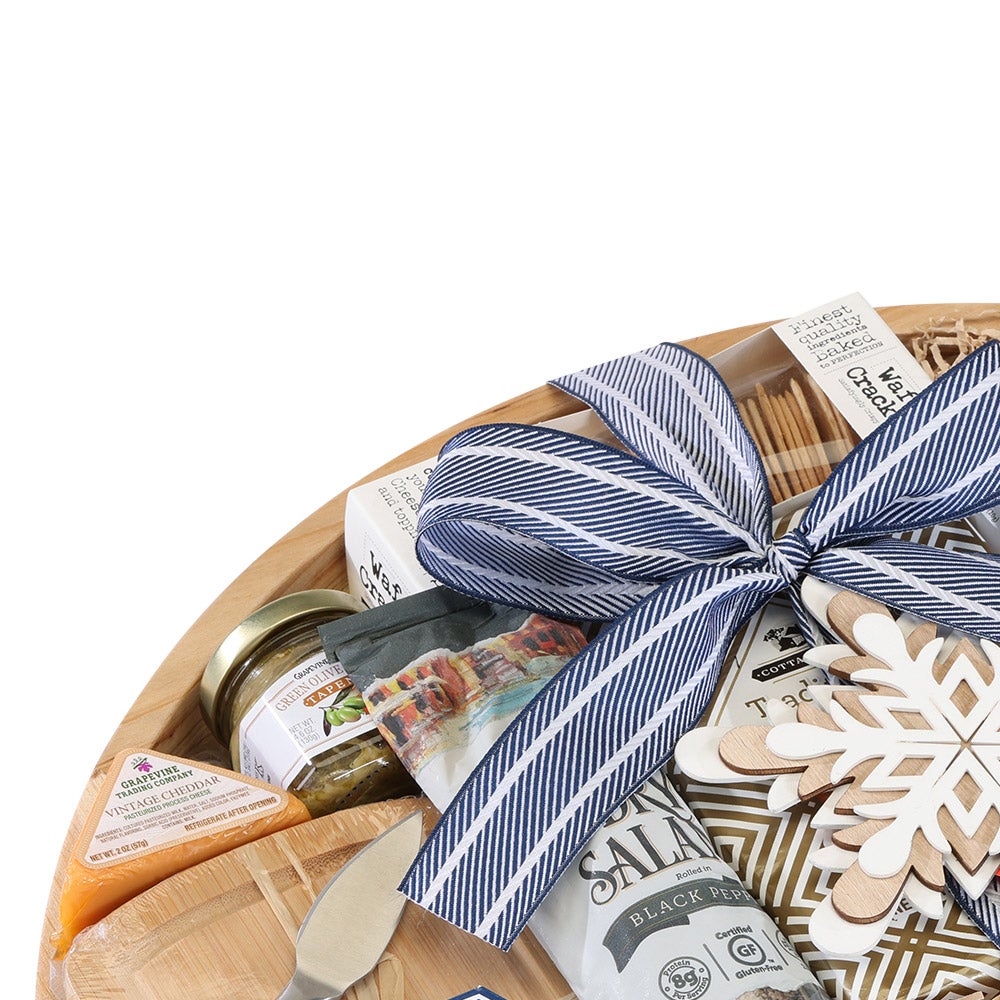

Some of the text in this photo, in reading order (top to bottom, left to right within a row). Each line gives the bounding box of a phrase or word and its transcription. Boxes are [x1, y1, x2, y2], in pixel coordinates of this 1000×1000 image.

[788, 303, 853, 335] Finest
[799, 314, 863, 345] quality
[807, 324, 868, 351] ingredients
[811, 332, 876, 363] baked
[832, 341, 884, 366] PERFECTION
[378, 487, 399, 507] and
[275, 664, 345, 712] GREEN OLIVE
[115, 769, 194, 799] TRADING COMPANY
[121, 765, 180, 789] GRAPEVINE
[105, 795, 160, 819] VINTAGE
[161, 775, 221, 800] CHEDDAR
[124, 804, 163, 821] PASTEURIZED
[162, 796, 190, 809] PROCESS
[189, 788, 213, 801] CHEESE
[184, 812, 231, 831] REFRIGERATE
[228, 804, 251, 818] AFTER
[248, 796, 277, 811] OPENING
[131, 838, 149, 850] (57g)
[676, 867, 703, 881] Rolled
[628, 889, 703, 928] BLACK
[715, 924, 754, 941] Certified
[736, 943, 758, 958] GF
[663, 959, 691, 977] Protein
[671, 969, 699, 988] 8g
[735, 963, 784, 980] Gluten-Free
